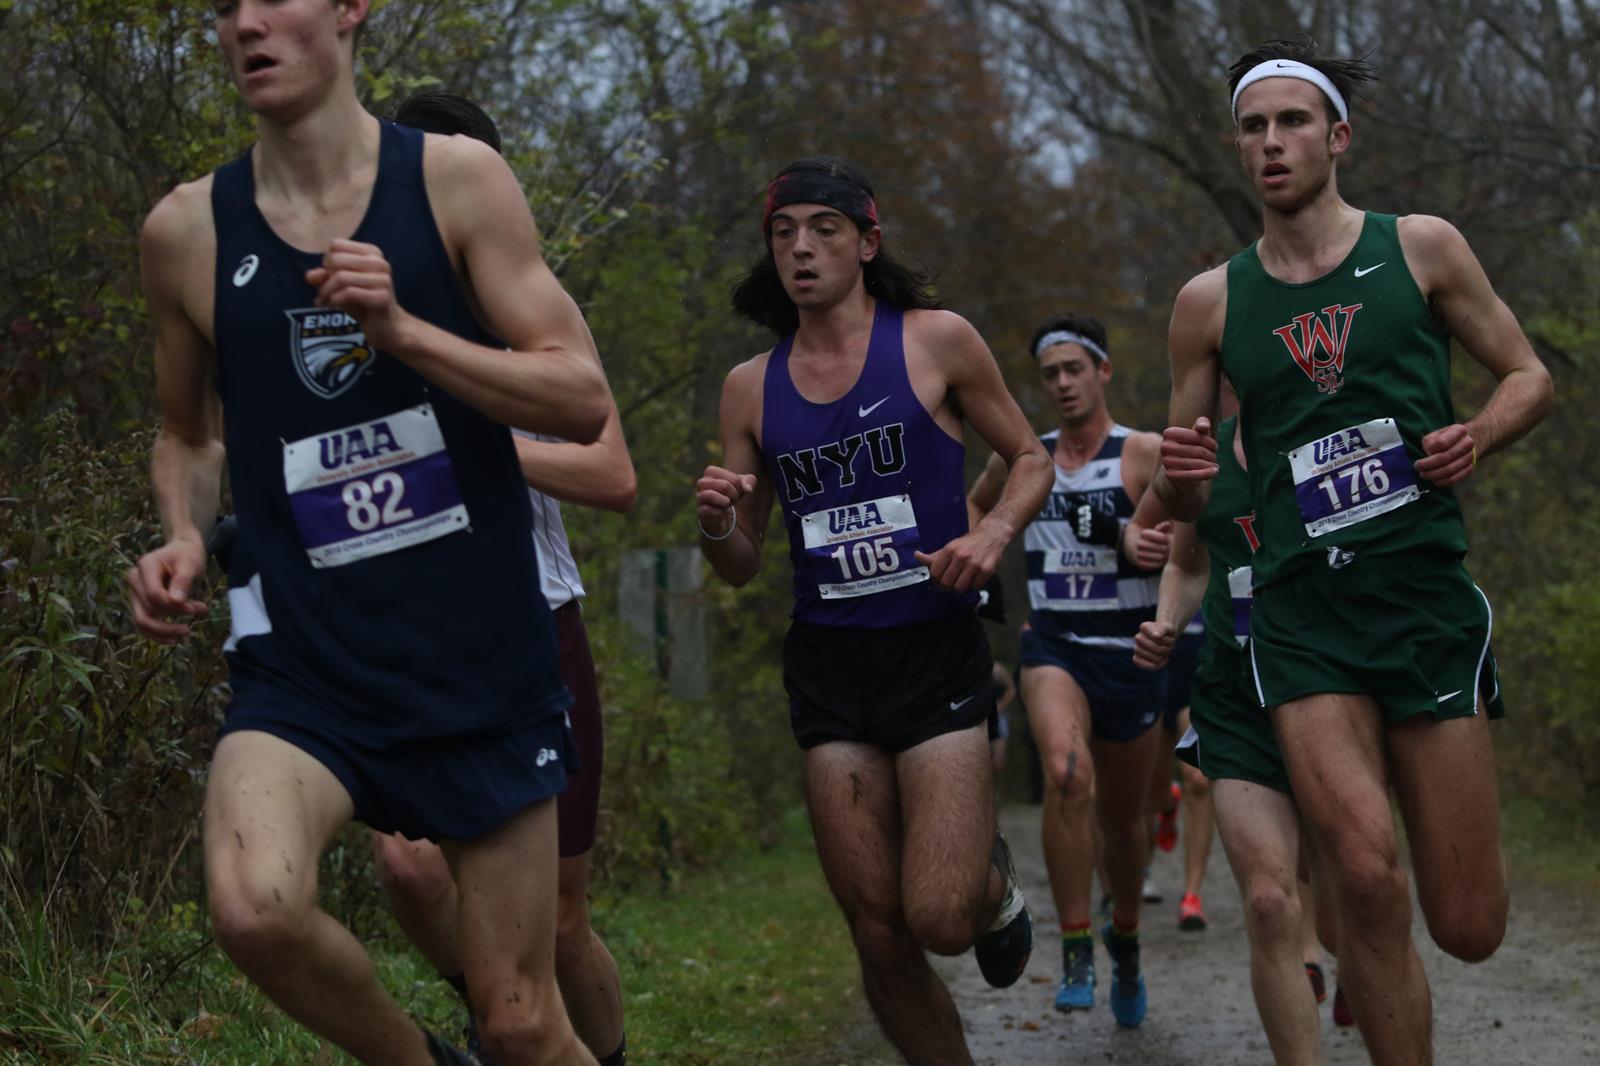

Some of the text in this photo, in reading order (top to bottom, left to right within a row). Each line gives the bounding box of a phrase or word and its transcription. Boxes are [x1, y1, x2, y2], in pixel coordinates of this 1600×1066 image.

[319, 422, 403, 470] UAA
[776, 422, 907, 502] NYU
[1313, 429, 1371, 464] UAA
[342, 471, 415, 531] 82
[1318, 458, 1390, 511] 176
[828, 503, 885, 534] UAA
[1347, 504, 1369, 518] Country
[366, 532, 394, 547] Country
[832, 536, 900, 580] 105
[1060, 551, 1096, 567] UAA
[857, 579, 877, 589] Country
[1066, 573, 1095, 599] 17
